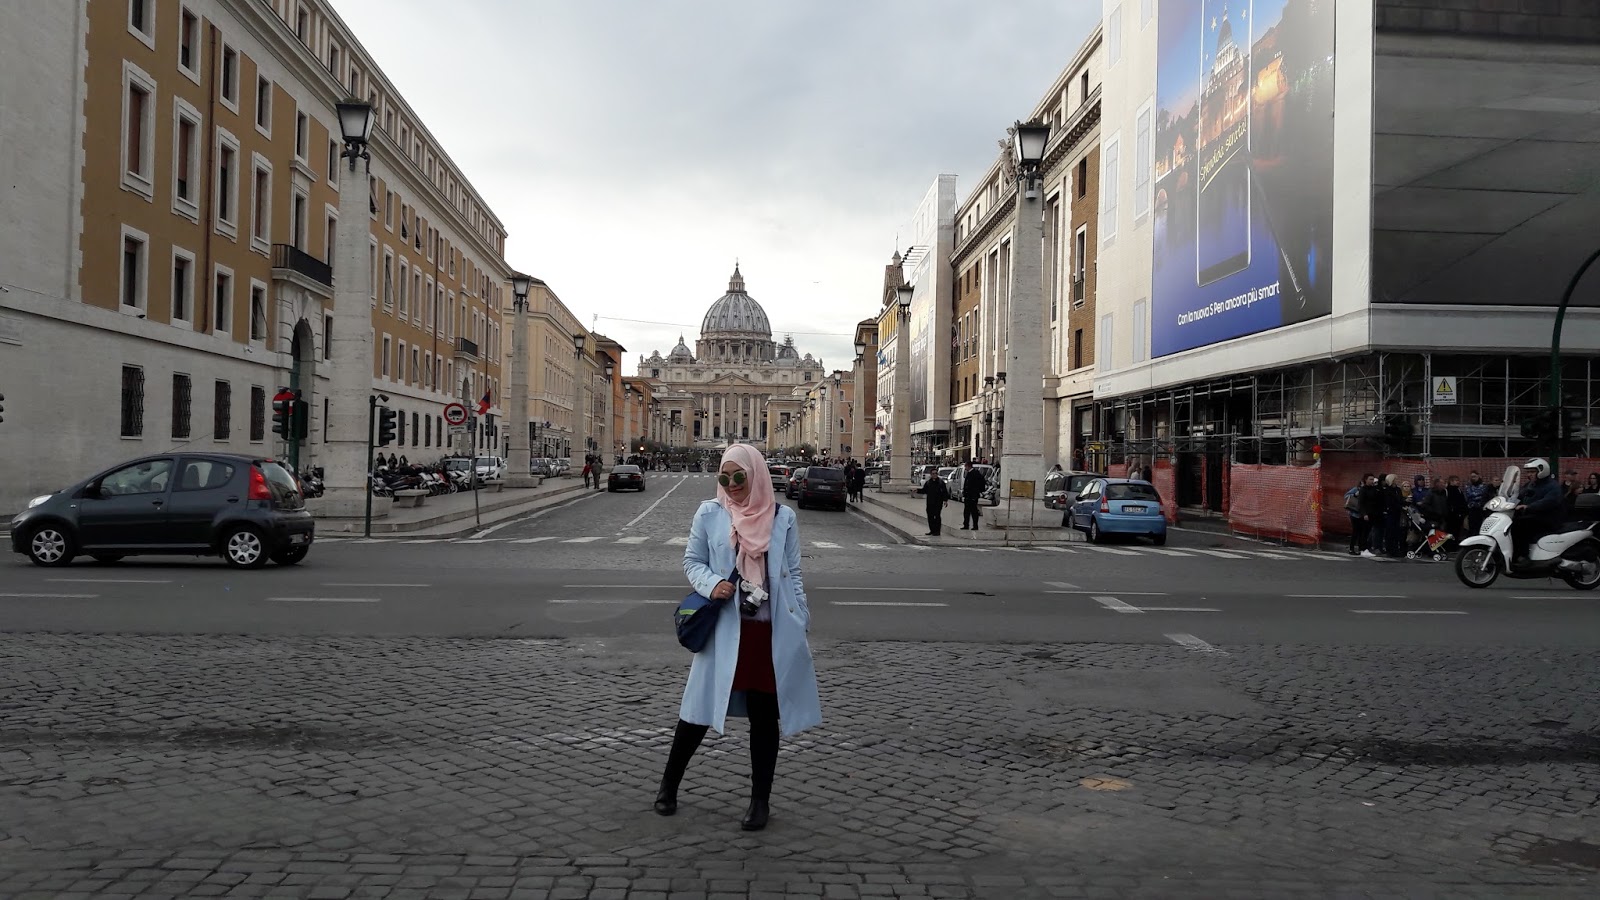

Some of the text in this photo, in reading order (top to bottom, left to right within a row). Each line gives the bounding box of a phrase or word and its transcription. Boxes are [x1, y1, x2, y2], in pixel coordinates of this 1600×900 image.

[1177, 280, 1280, 325] Con la nuova S Pen ancora più smart
